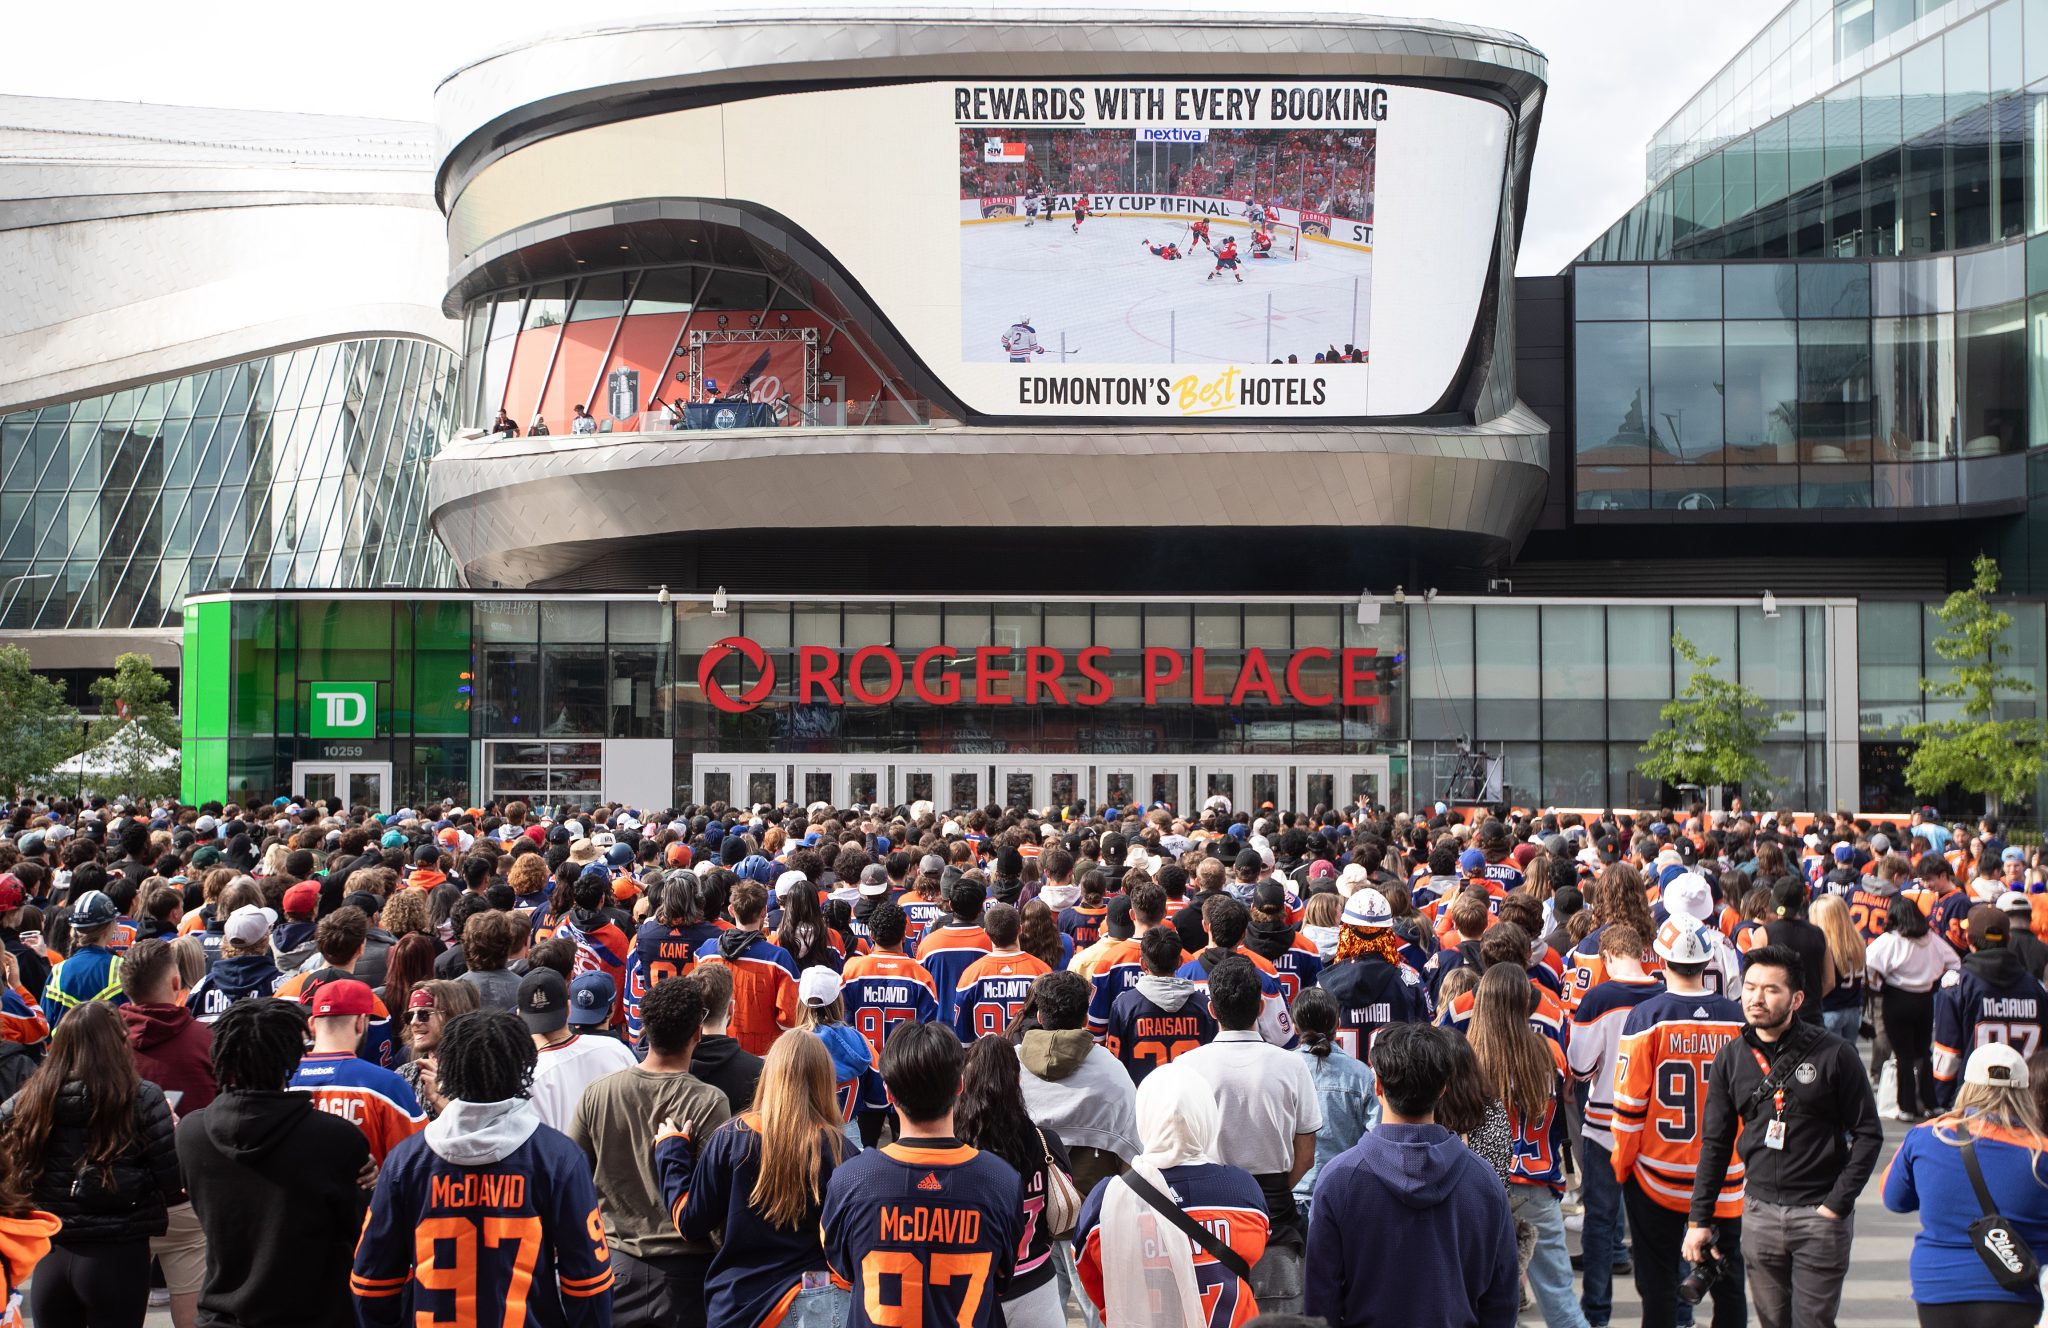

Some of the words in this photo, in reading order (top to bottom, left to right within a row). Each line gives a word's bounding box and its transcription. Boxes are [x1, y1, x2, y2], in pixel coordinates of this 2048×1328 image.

[955, 88, 1085, 120] REWARDS
[1096, 89, 1164, 120] WITH
[1175, 89, 1260, 121] EVERY
[1271, 88, 1388, 122] BOOKING
[1144, 128, 1202, 142] nextiva
[1119, 196, 1156, 211] CUP
[1176, 198, 1230, 217] FINAL
[1353, 225, 1374, 244] ST
[1019, 377, 1171, 406] EDMONTON'S
[1171, 365, 1242, 408] Best
[1241, 377, 1326, 406] HOTELS
[800, 645, 1114, 706] ROGERS
[1144, 646, 1380, 706] PLACE
[316, 692, 367, 727] TD
[323, 746, 363, 757] 10259
[543, 913, 556, 927] KA
[659, 942, 690, 960] KANE
[863, 986, 908, 1003] McDAVID
[1982, 996, 2037, 1019] McDAVID
[1350, 1003, 1391, 1024] HYMAN
[1137, 1017, 1201, 1037] DRAISAITL
[300, 1066, 336, 1077] Reebok
[310, 1097, 365, 1126] AGIC
[1655, 1059, 1713, 1144] 9
[431, 1173, 526, 1209] McDAVID
[917, 1183, 942, 1191] adidas
[879, 1206, 981, 1245] McDAVID
[1017, 1194, 1046, 1261] 7
[1983, 1228, 2026, 1274] Oilers
[415, 1216, 543, 1328] 97
[861, 1250, 994, 1328] 97
